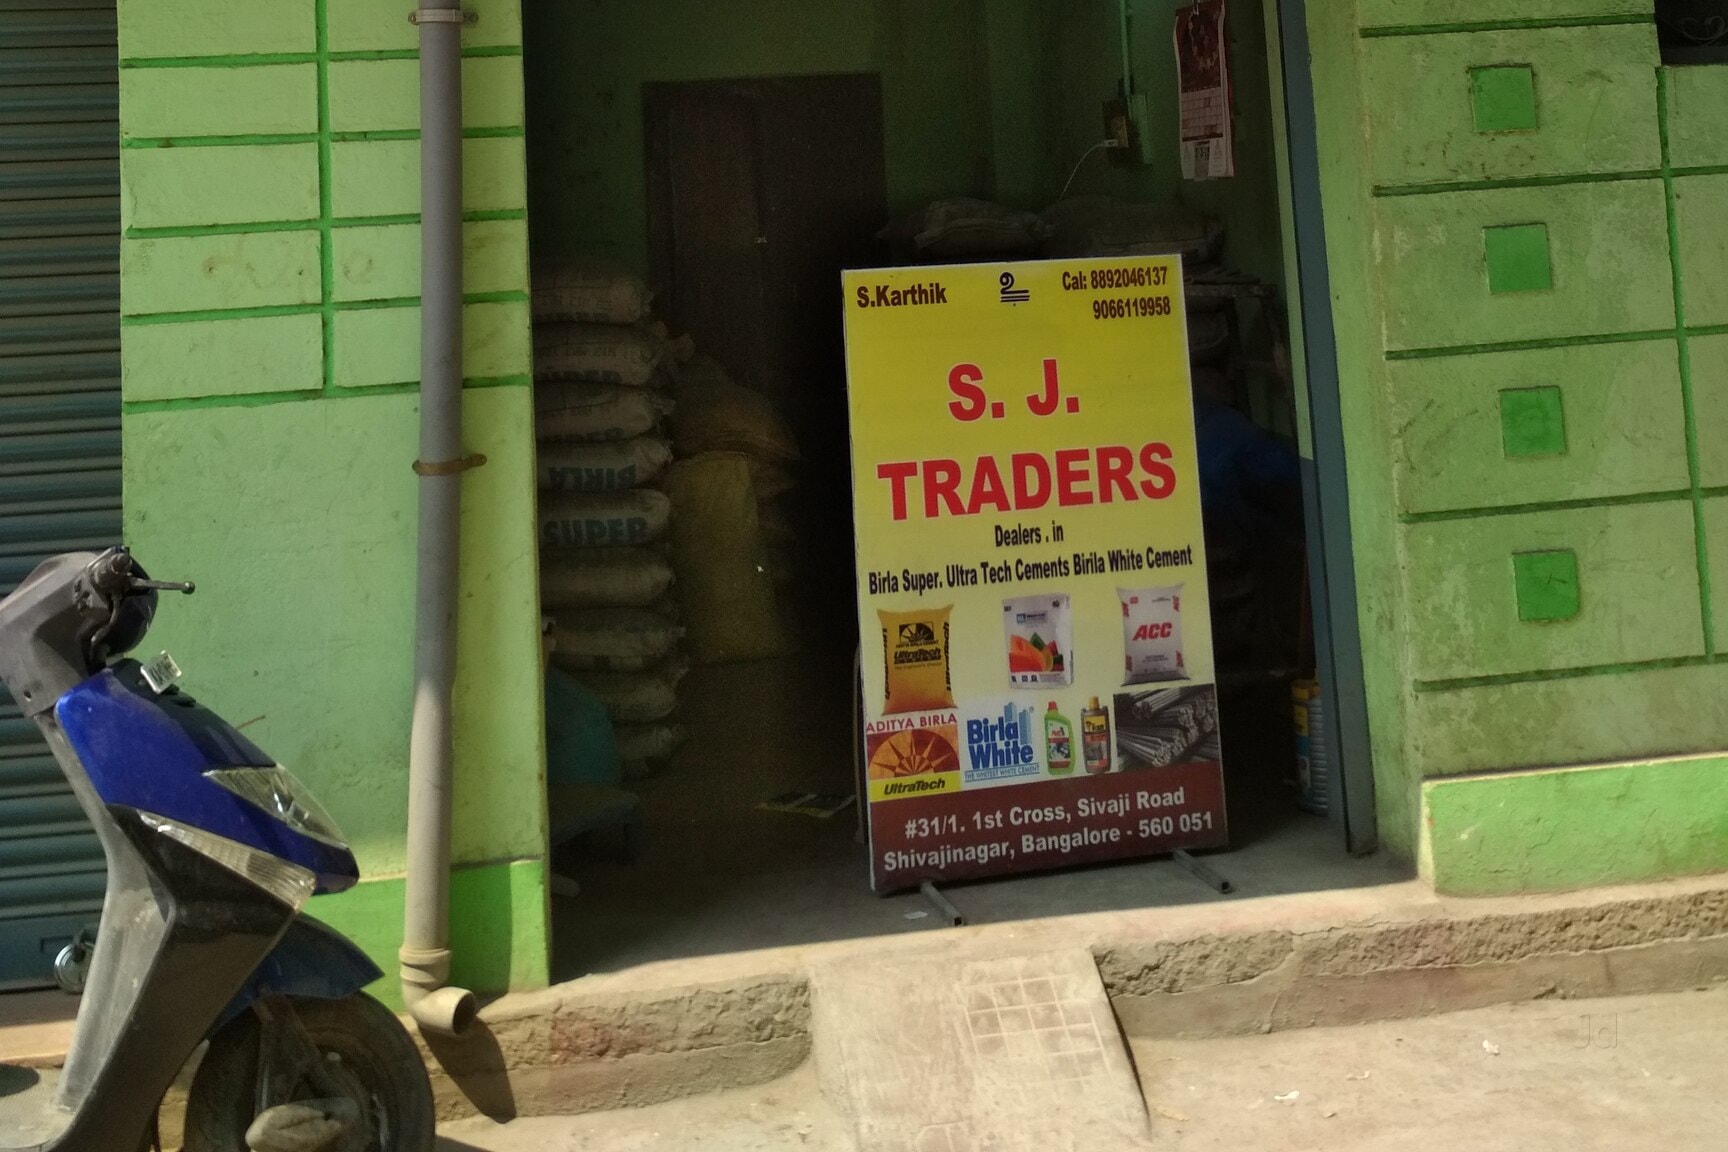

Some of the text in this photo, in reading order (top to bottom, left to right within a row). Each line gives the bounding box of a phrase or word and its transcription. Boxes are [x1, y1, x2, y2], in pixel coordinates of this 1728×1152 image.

[1062, 266, 1167, 290] Cal: 8892046137
[857, 283, 947, 308] S.Karthik
[1093, 296, 1171, 319] 9066119958
[949, 359, 1079, 421] S. J.
[878, 443, 1176, 520] TRADERS
[543, 517, 648, 546] SUPER
[995, 523, 1041, 547] Dealers
[1052, 520, 1063, 542] in
[869, 545, 1192, 596] Birla Super. Ultra Tech Cements Birila White Cement
[1133, 622, 1172, 641] ACC
[866, 713, 957, 733] ADITYA BIRLA
[967, 717, 1018, 744] Birla
[968, 739, 1033, 769] White
[884, 777, 945, 795] UltraTech
[905, 787, 1184, 838] #31/1. 1st Cross, Sivaji Road
[884, 841, 1014, 871] Shivajinagar,
[1022, 827, 1120, 853] Bangalore
[1139, 816, 1173, 837] 560
[1180, 811, 1212, 832] 051
